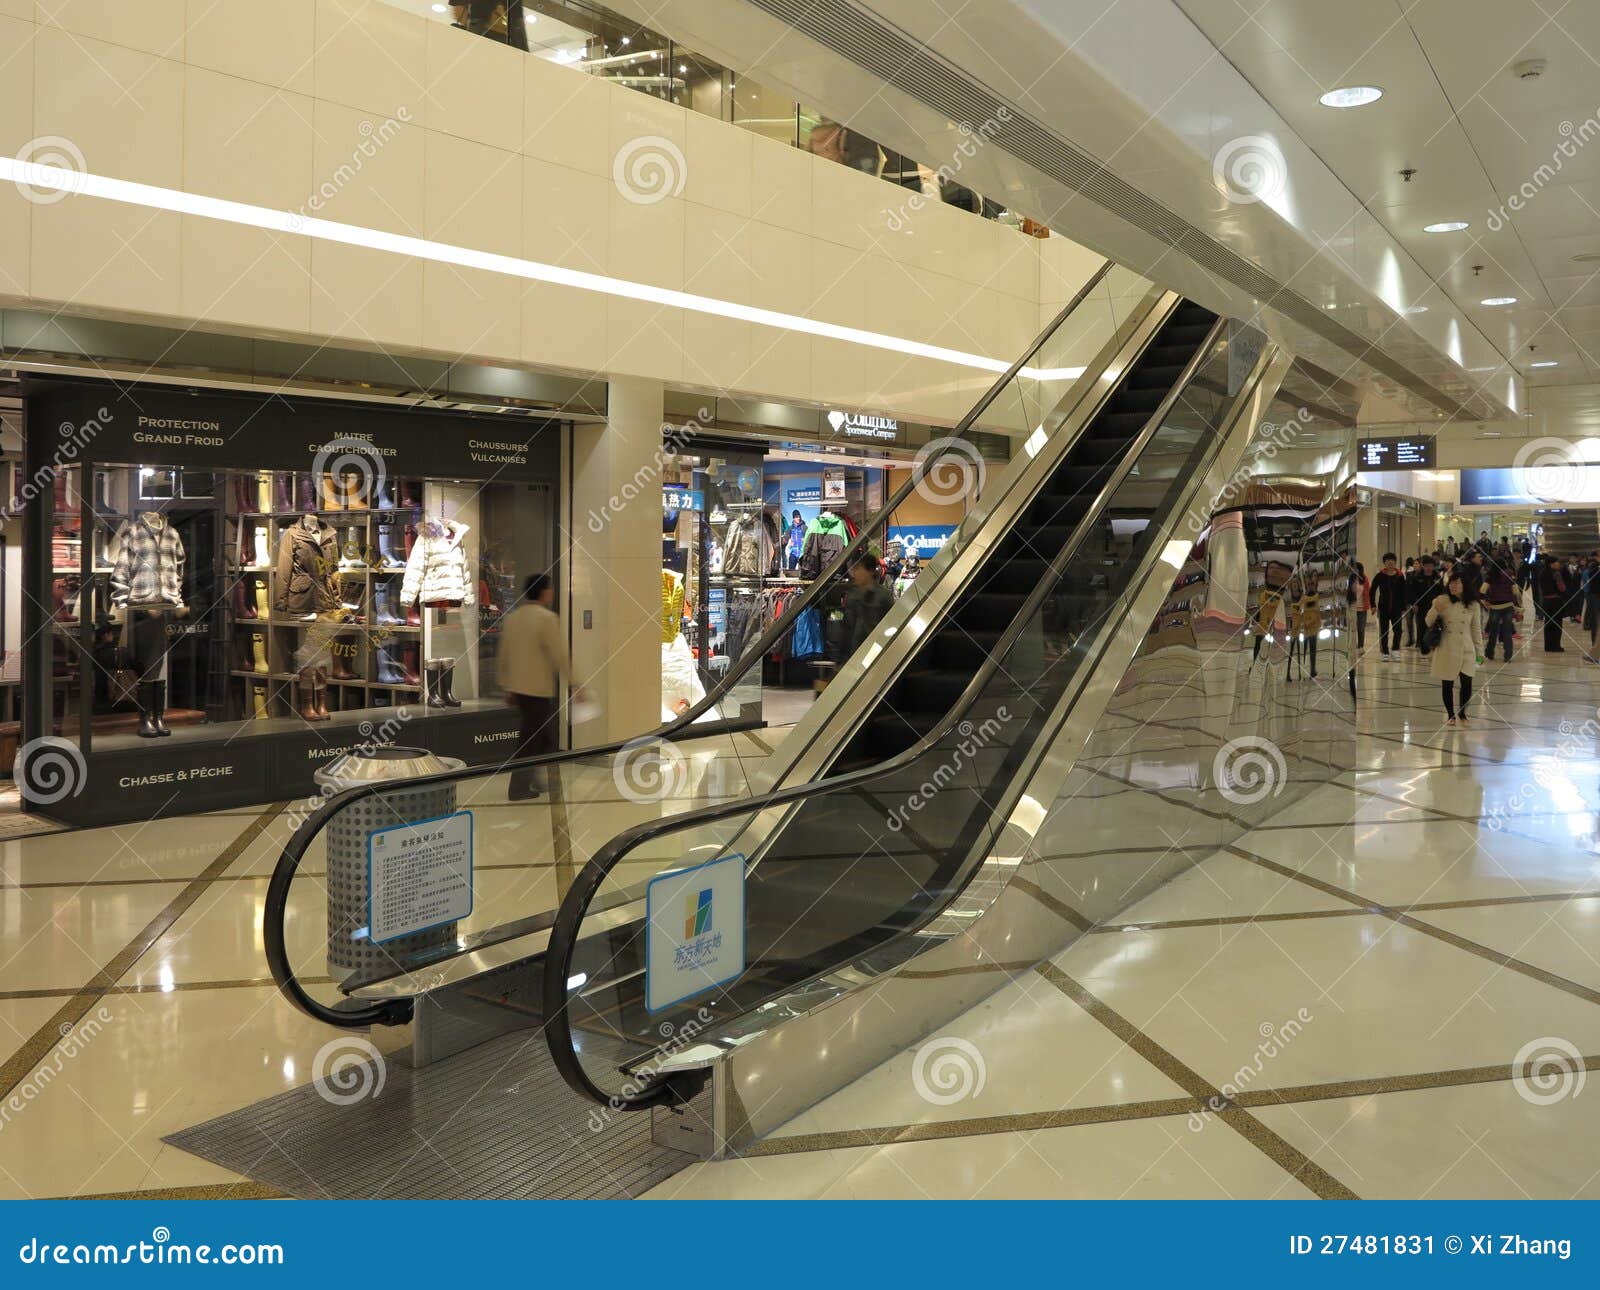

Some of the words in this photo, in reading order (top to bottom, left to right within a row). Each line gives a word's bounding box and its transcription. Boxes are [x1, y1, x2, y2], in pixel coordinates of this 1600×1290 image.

[138, 416, 220, 431] PROTECTION
[133, 431, 182, 444] GRAND
[185, 434, 224, 446] FROID
[468, 439, 529, 452] CHAUSSURES
[308, 443, 398, 457] CAOUTCHOUTIER
[904, 534, 950, 548] Columb
[474, 730, 521, 744] NAUTISME
[119, 773, 175, 788] CHASSE
[176, 770, 187, 781] &
[190, 766, 233, 779] PÊCHE
